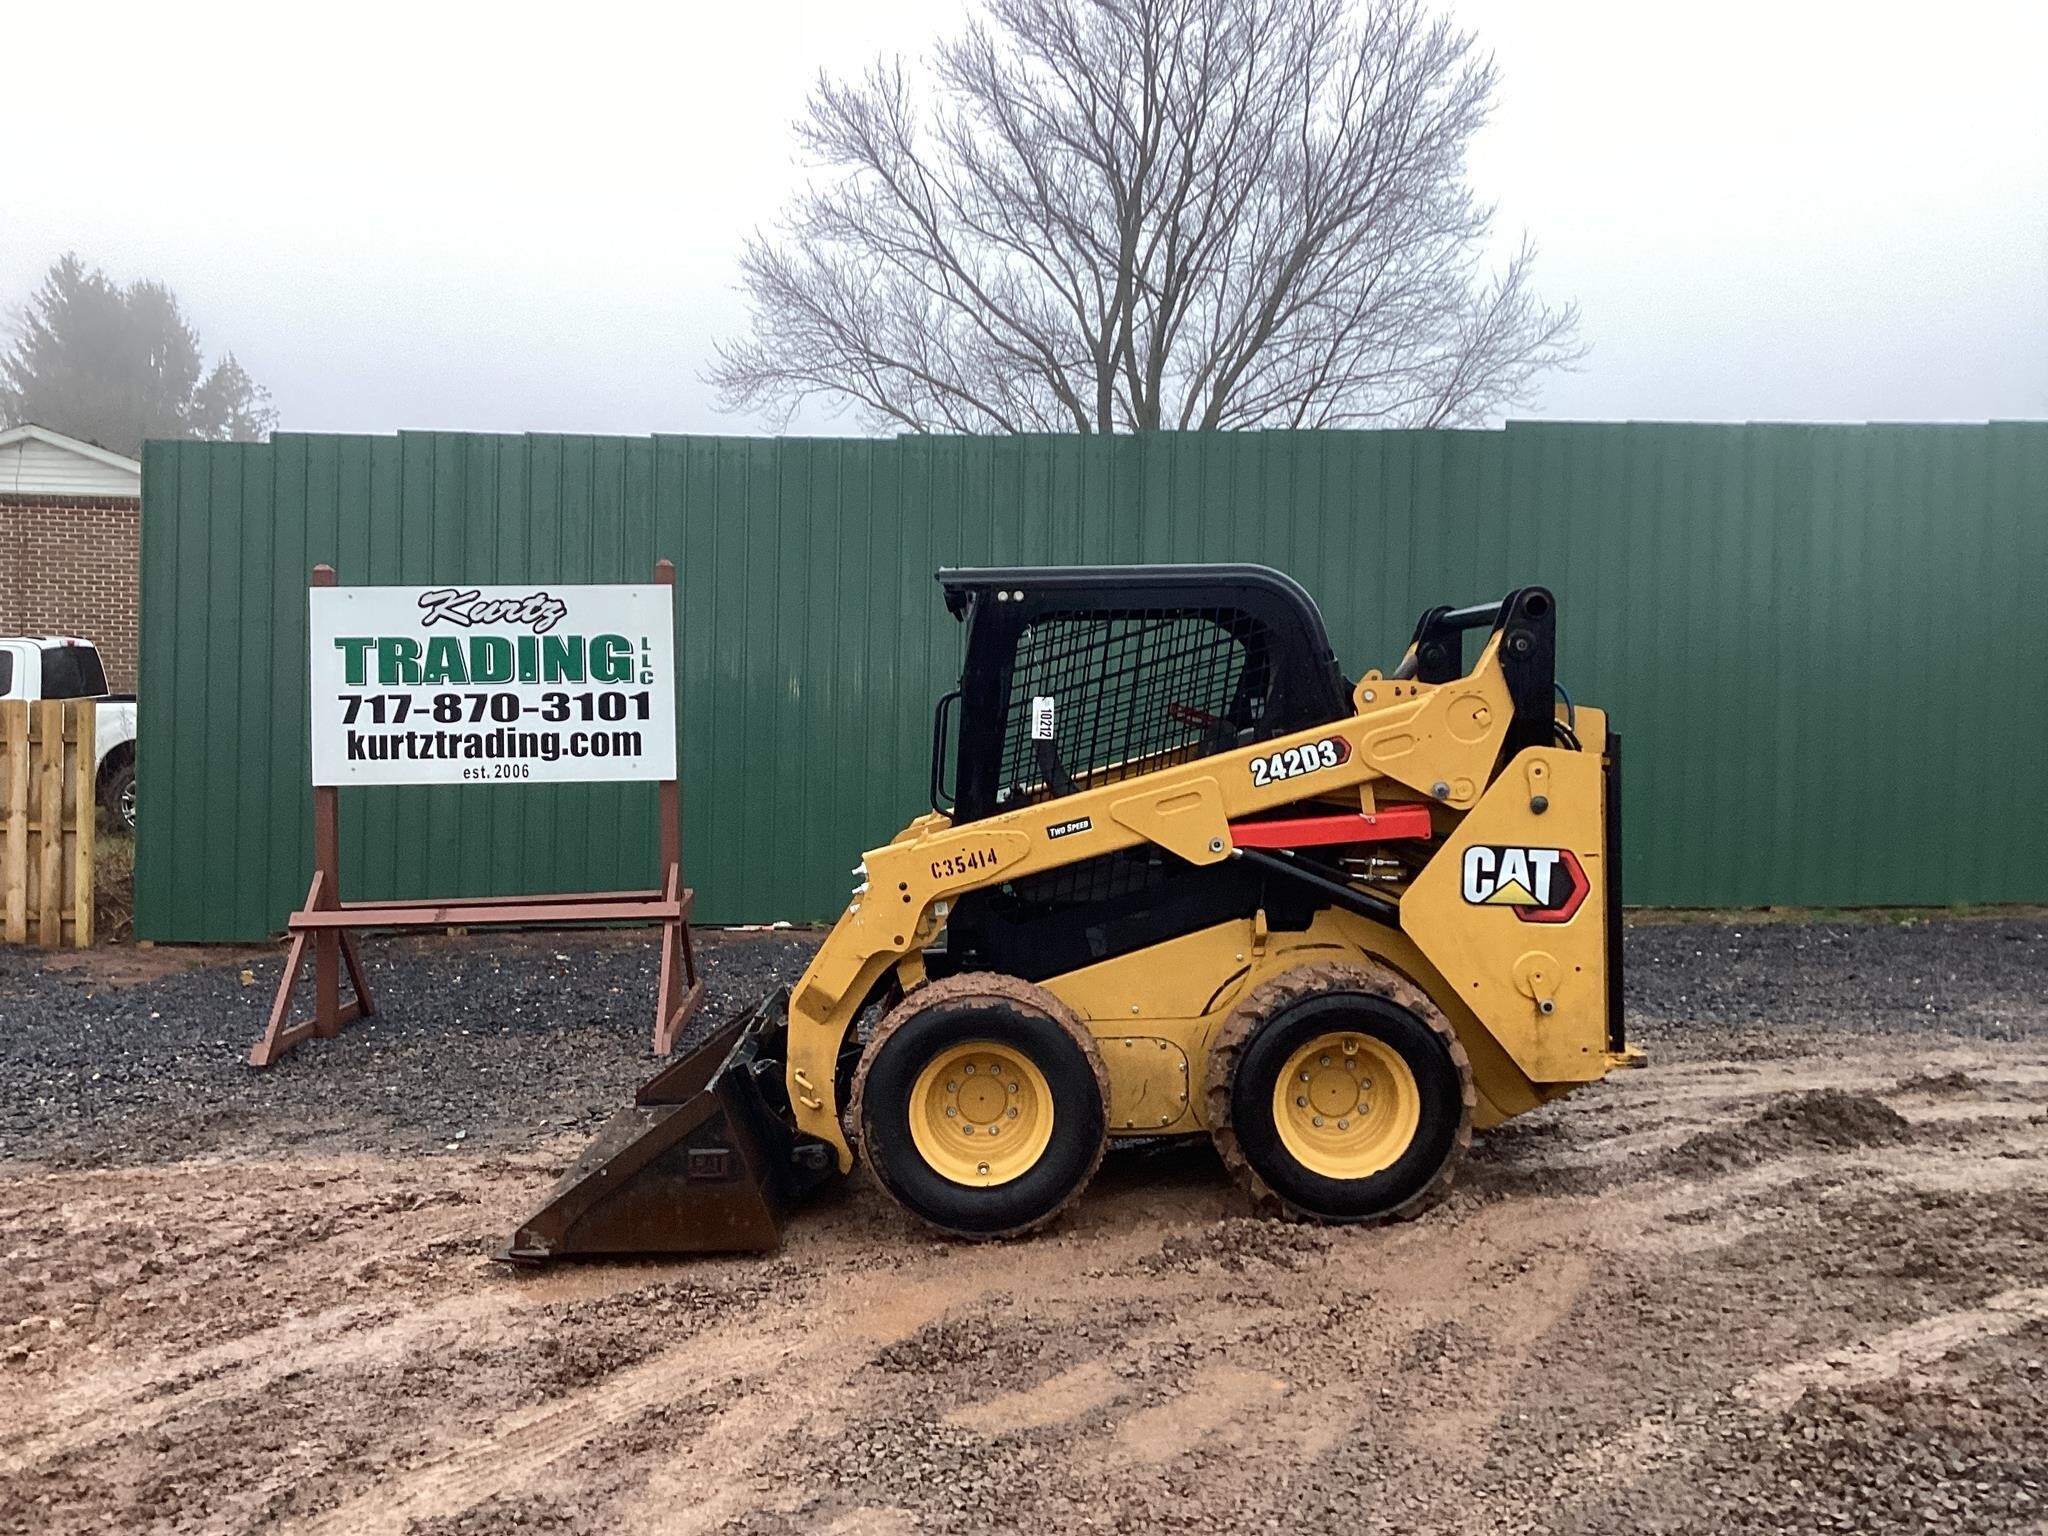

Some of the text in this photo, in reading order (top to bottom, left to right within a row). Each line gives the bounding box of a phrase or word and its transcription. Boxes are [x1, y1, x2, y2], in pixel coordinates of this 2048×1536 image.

[419, 589, 567, 633] Kurtz
[334, 634, 635, 686] TRADING
[338, 691, 650, 724] 717-870-3101
[1040, 708, 1053, 738] 10212
[347, 727, 642, 762] kurtztrading.com
[463, 764, 530, 779] est. 2006
[1250, 739, 1338, 787] 242D3
[931, 847, 998, 879] C35414
[1463, 846, 1560, 906] CAT
